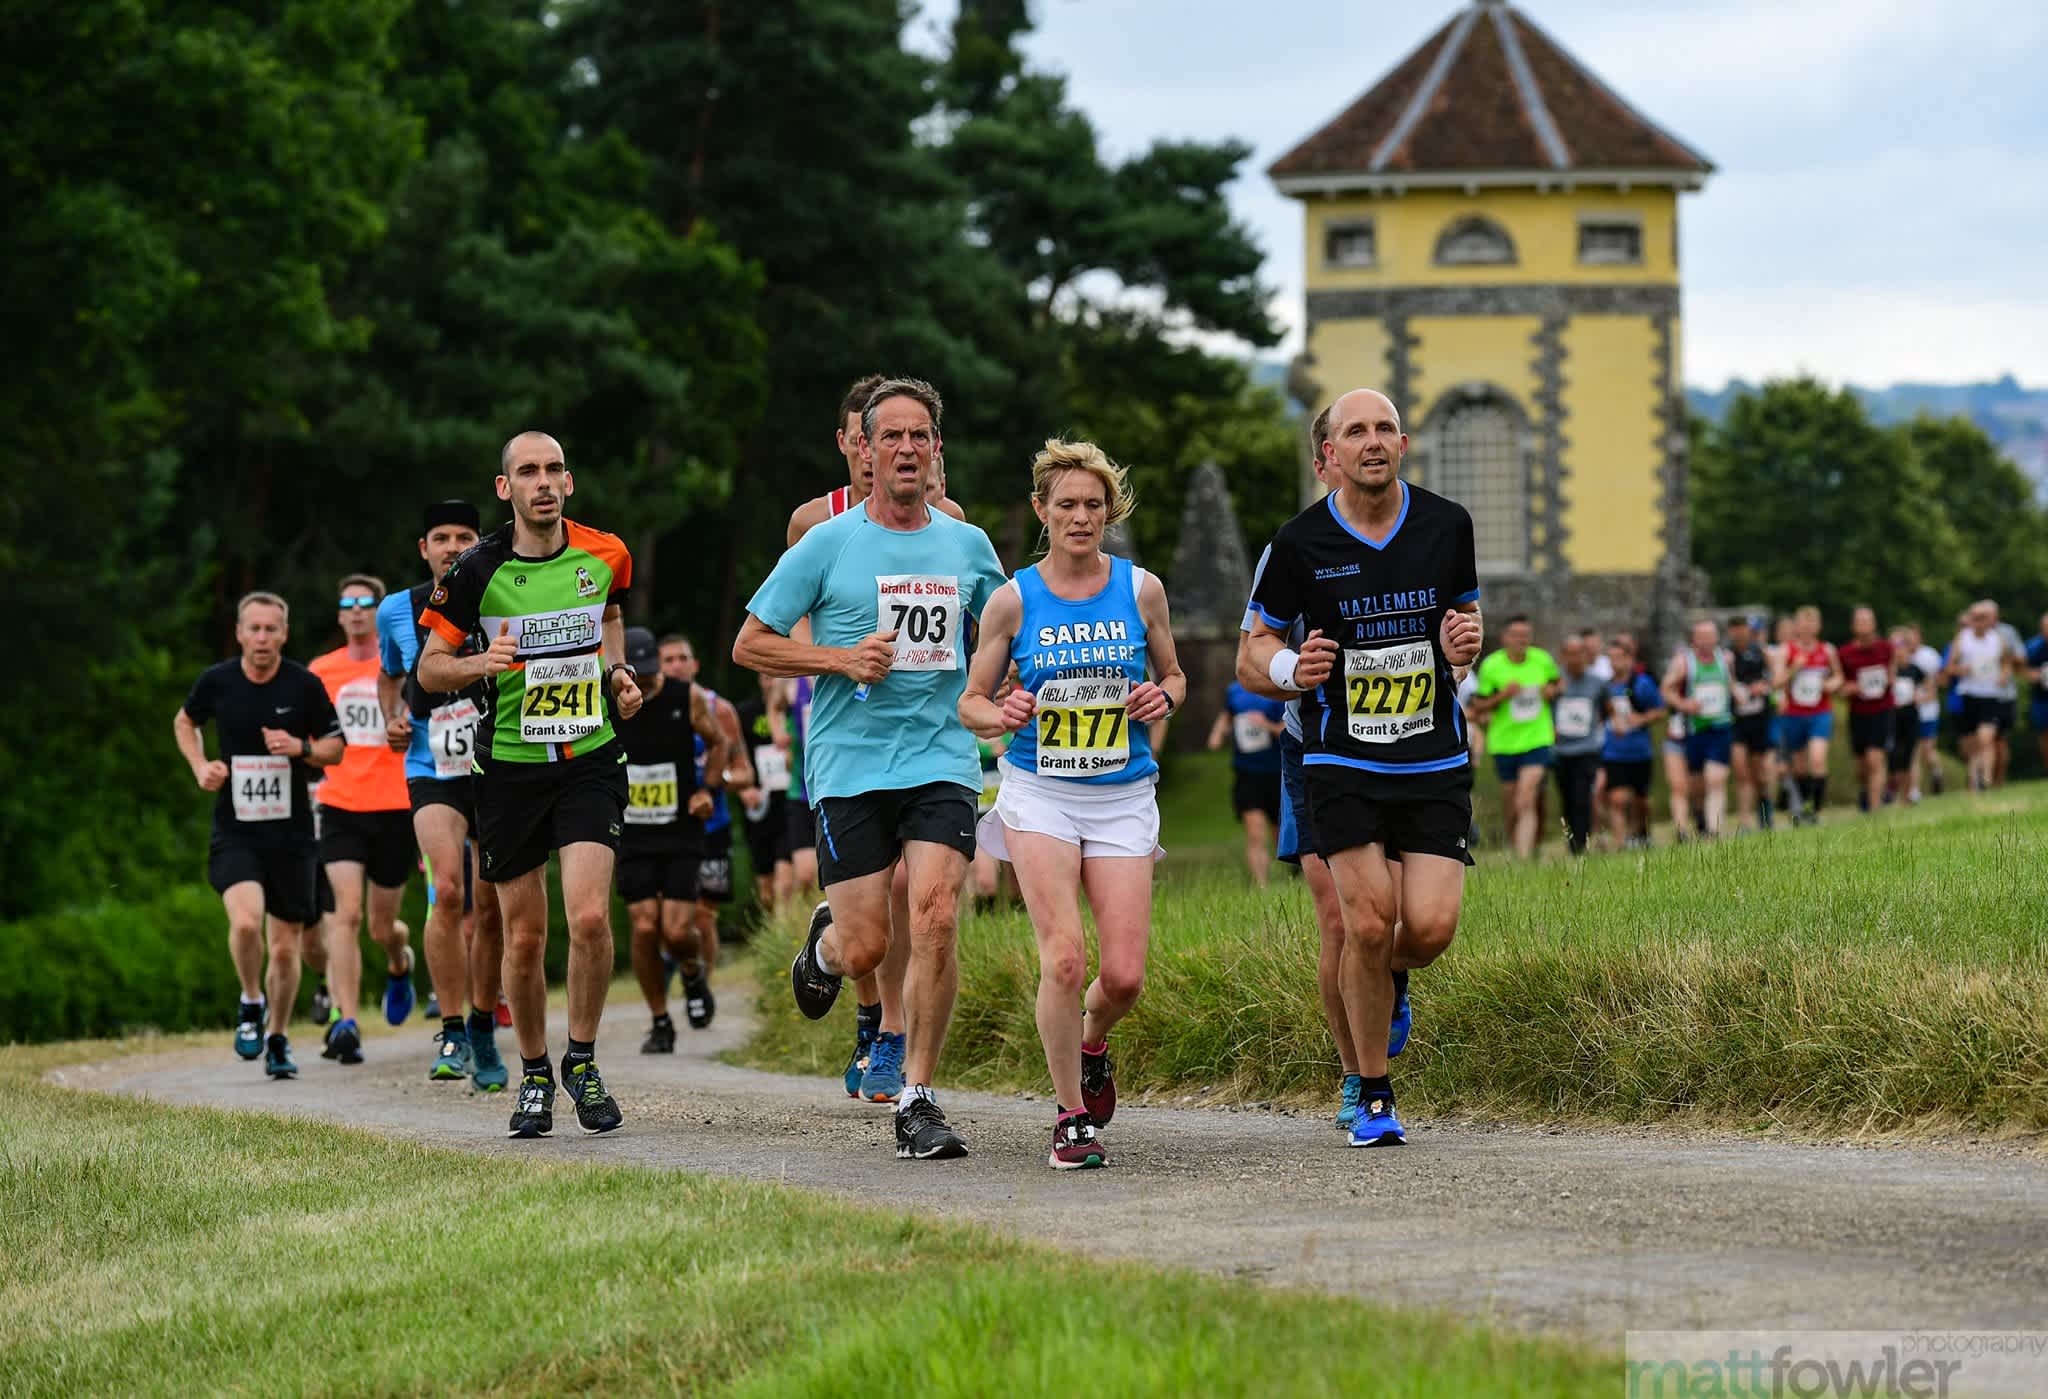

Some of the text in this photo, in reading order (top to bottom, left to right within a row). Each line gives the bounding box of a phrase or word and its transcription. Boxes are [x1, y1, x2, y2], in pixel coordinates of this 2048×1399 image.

[880, 582, 957, 596] Grant & Stone
[1338, 588, 1438, 617] HAZLEMERE
[890, 604, 948, 644] 703
[1038, 620, 1127, 648] SARAH
[1356, 617, 1427, 640] RUNNERS
[1033, 645, 1136, 670] HAZLEMERE
[1349, 648, 1428, 672] HELL-FIRE 10K
[530, 663, 581, 680] HELL-FIRE
[525, 683, 594, 717] 2541
[1041, 684, 1124, 703] HELL-FIRE 10K
[1350, 672, 1433, 715] 2272
[345, 703, 378, 729] 501
[1041, 707, 1126, 748] 2177
[1352, 717, 1431, 736] Grant & Stone
[524, 724, 556, 736] Grant
[558, 724, 566, 736] &
[1041, 756, 1127, 769] Grant & Stone
[241, 776, 281, 802] 444
